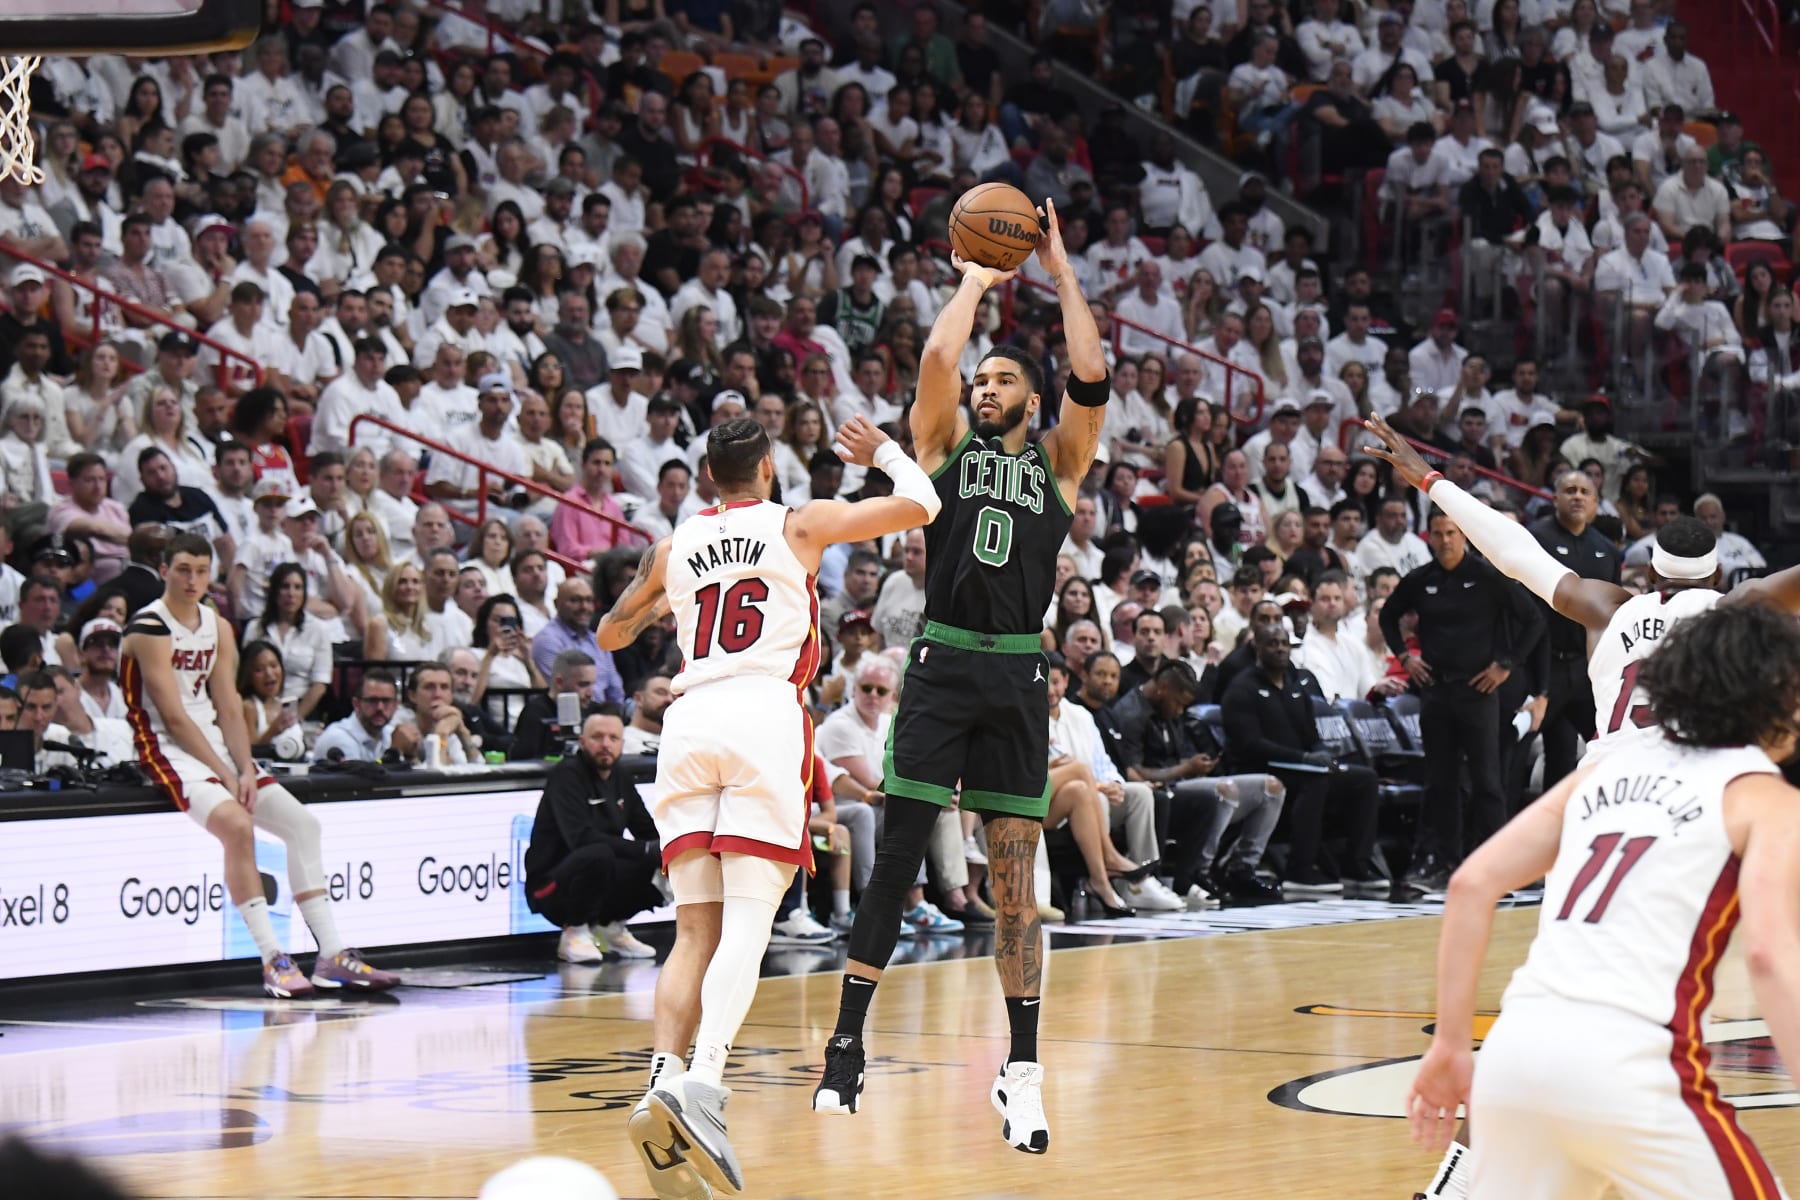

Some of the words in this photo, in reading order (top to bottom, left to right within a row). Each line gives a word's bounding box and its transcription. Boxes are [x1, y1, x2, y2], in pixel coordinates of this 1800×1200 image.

[989, 217, 1037, 244] Wilson
[687, 537, 766, 578] MARTIN
[973, 505, 1013, 568] 0
[693, 577, 770, 660] 16
[1620, 618, 1665, 653] ADEB
[172, 648, 215, 671] HEAT
[1667, 795, 1703, 837] JR.
[359, 862, 373, 900] 8
[418, 852, 511, 901] Google
[1555, 832, 1659, 924] 11
[0, 884, 43, 927] xel
[53, 883, 69, 924] 8
[120, 873, 223, 925] Google
